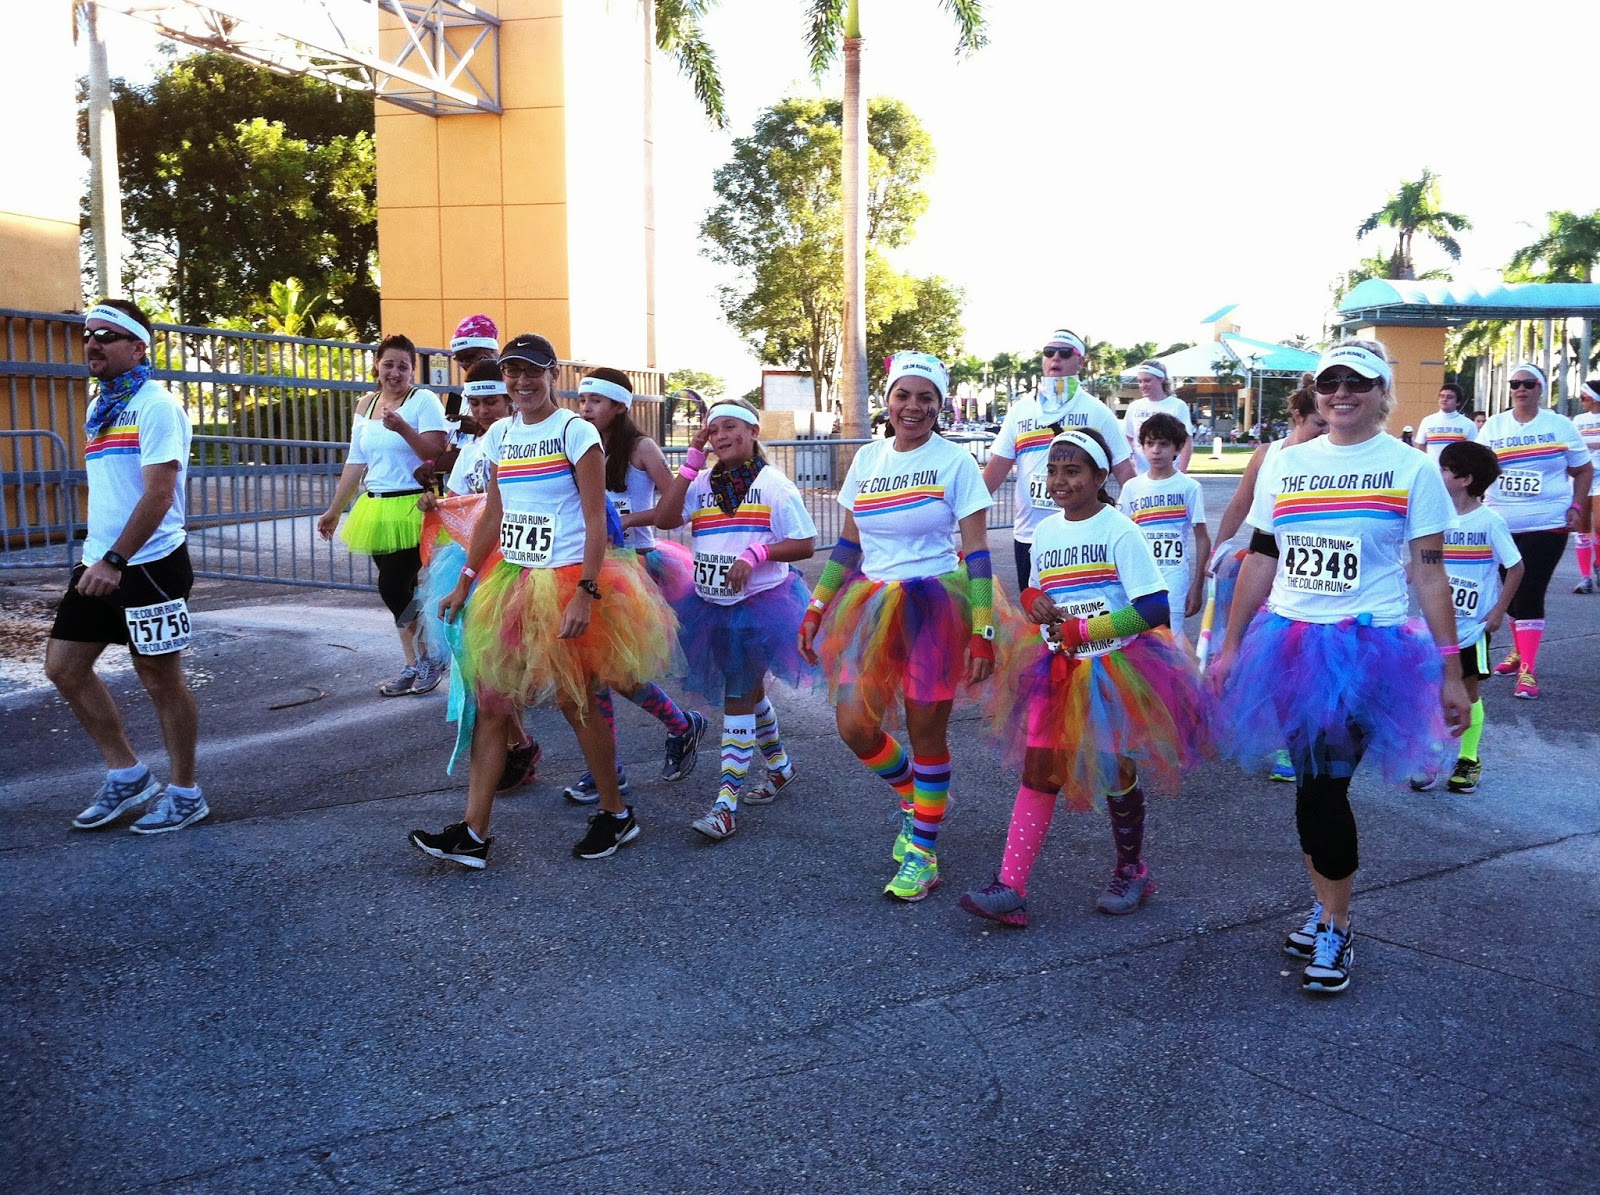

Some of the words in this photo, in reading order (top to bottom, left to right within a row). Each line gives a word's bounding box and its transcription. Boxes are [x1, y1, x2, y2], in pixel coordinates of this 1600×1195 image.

[430, 359, 448, 369] GATE
[436, 369, 443, 385] 3
[118, 410, 139, 427] RUN
[1016, 418, 1033, 434] THE
[1067, 412, 1089, 427] RUN
[507, 442, 538, 460] COLOR
[538, 437, 562, 457] RUN
[1489, 438, 1505, 451] THE
[1505, 434, 1537, 448] COLOR
[1538, 432, 1557, 443] RUN
[869, 474, 910, 494] COLOR
[911, 469, 939, 487] RUN
[1281, 474, 1308, 494] THE
[1309, 474, 1359, 491] COLOR
[1361, 470, 1395, 489] RUN
[1499, 475, 1540, 492] 76562
[1140, 494, 1166, 510] COLOR
[1166, 493, 1185, 506] RUN
[510, 512, 528, 525] COLOR
[527, 514, 543, 526] RUN
[501, 522, 552, 552] 55745
[1146, 532, 1164, 540] COLOR
[1164, 532, 1177, 540] RUN
[1286, 535, 1301, 546] THE
[1300, 535, 1328, 549] COLOR
[1328, 538, 1346, 551] RUN
[1467, 531, 1487, 546] RUN
[508, 550, 526, 562] COLOR
[526, 551, 541, 563] RUN
[1043, 545, 1079, 570] COLOR
[1081, 543, 1108, 564] RUN
[1153, 539, 1183, 558] 879
[701, 552, 719, 564] COLOR
[719, 554, 733, 565] RUN
[1164, 559, 1177, 567] RUN
[1285, 547, 1358, 581] 42348
[693, 560, 730, 587] 7575
[701, 586, 719, 596] COLOR
[719, 587, 733, 597] RUN
[1287, 576, 1299, 588] THE
[1298, 577, 1324, 592] COLOR
[1324, 579, 1344, 593] RUN
[1460, 579, 1474, 589] RUN
[140, 606, 165, 619] COLOR
[164, 602, 179, 616] RUN
[1080, 601, 1098, 613] RUN
[128, 611, 190, 643] 75758
[149, 640, 173, 653] COLOR
[172, 637, 186, 649] RUN
[1076, 642, 1091, 654] LOR
[1090, 639, 1108, 652] RUN
